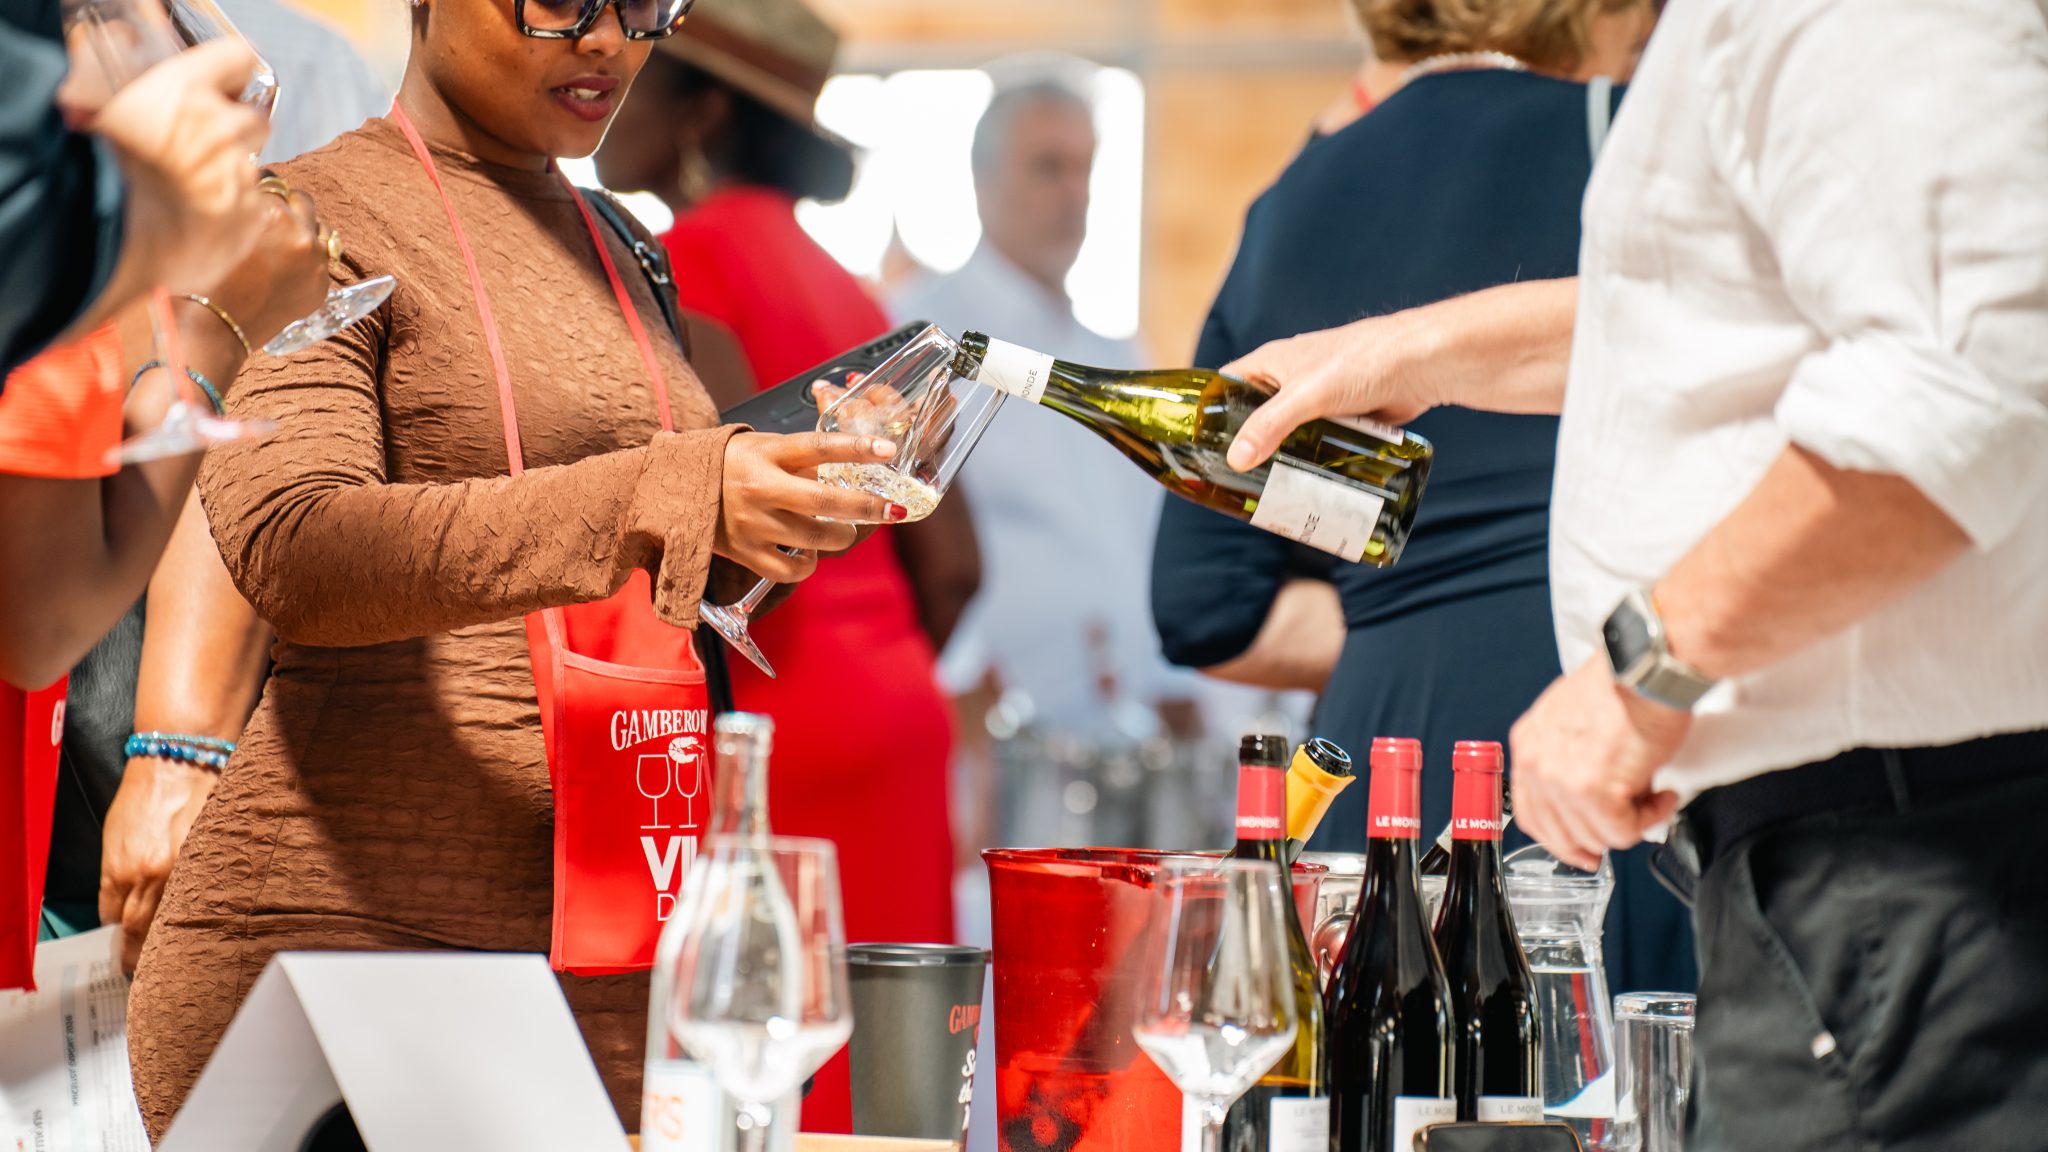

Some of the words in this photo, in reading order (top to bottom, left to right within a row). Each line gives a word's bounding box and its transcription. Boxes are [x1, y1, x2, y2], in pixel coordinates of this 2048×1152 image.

[610, 709, 700, 751] GAMBERO
[1375, 815, 1390, 827] LE
[1455, 818, 1468, 829] LE
[1418, 1106, 1432, 1117] LE
[1500, 1104, 1514, 1115] LE
